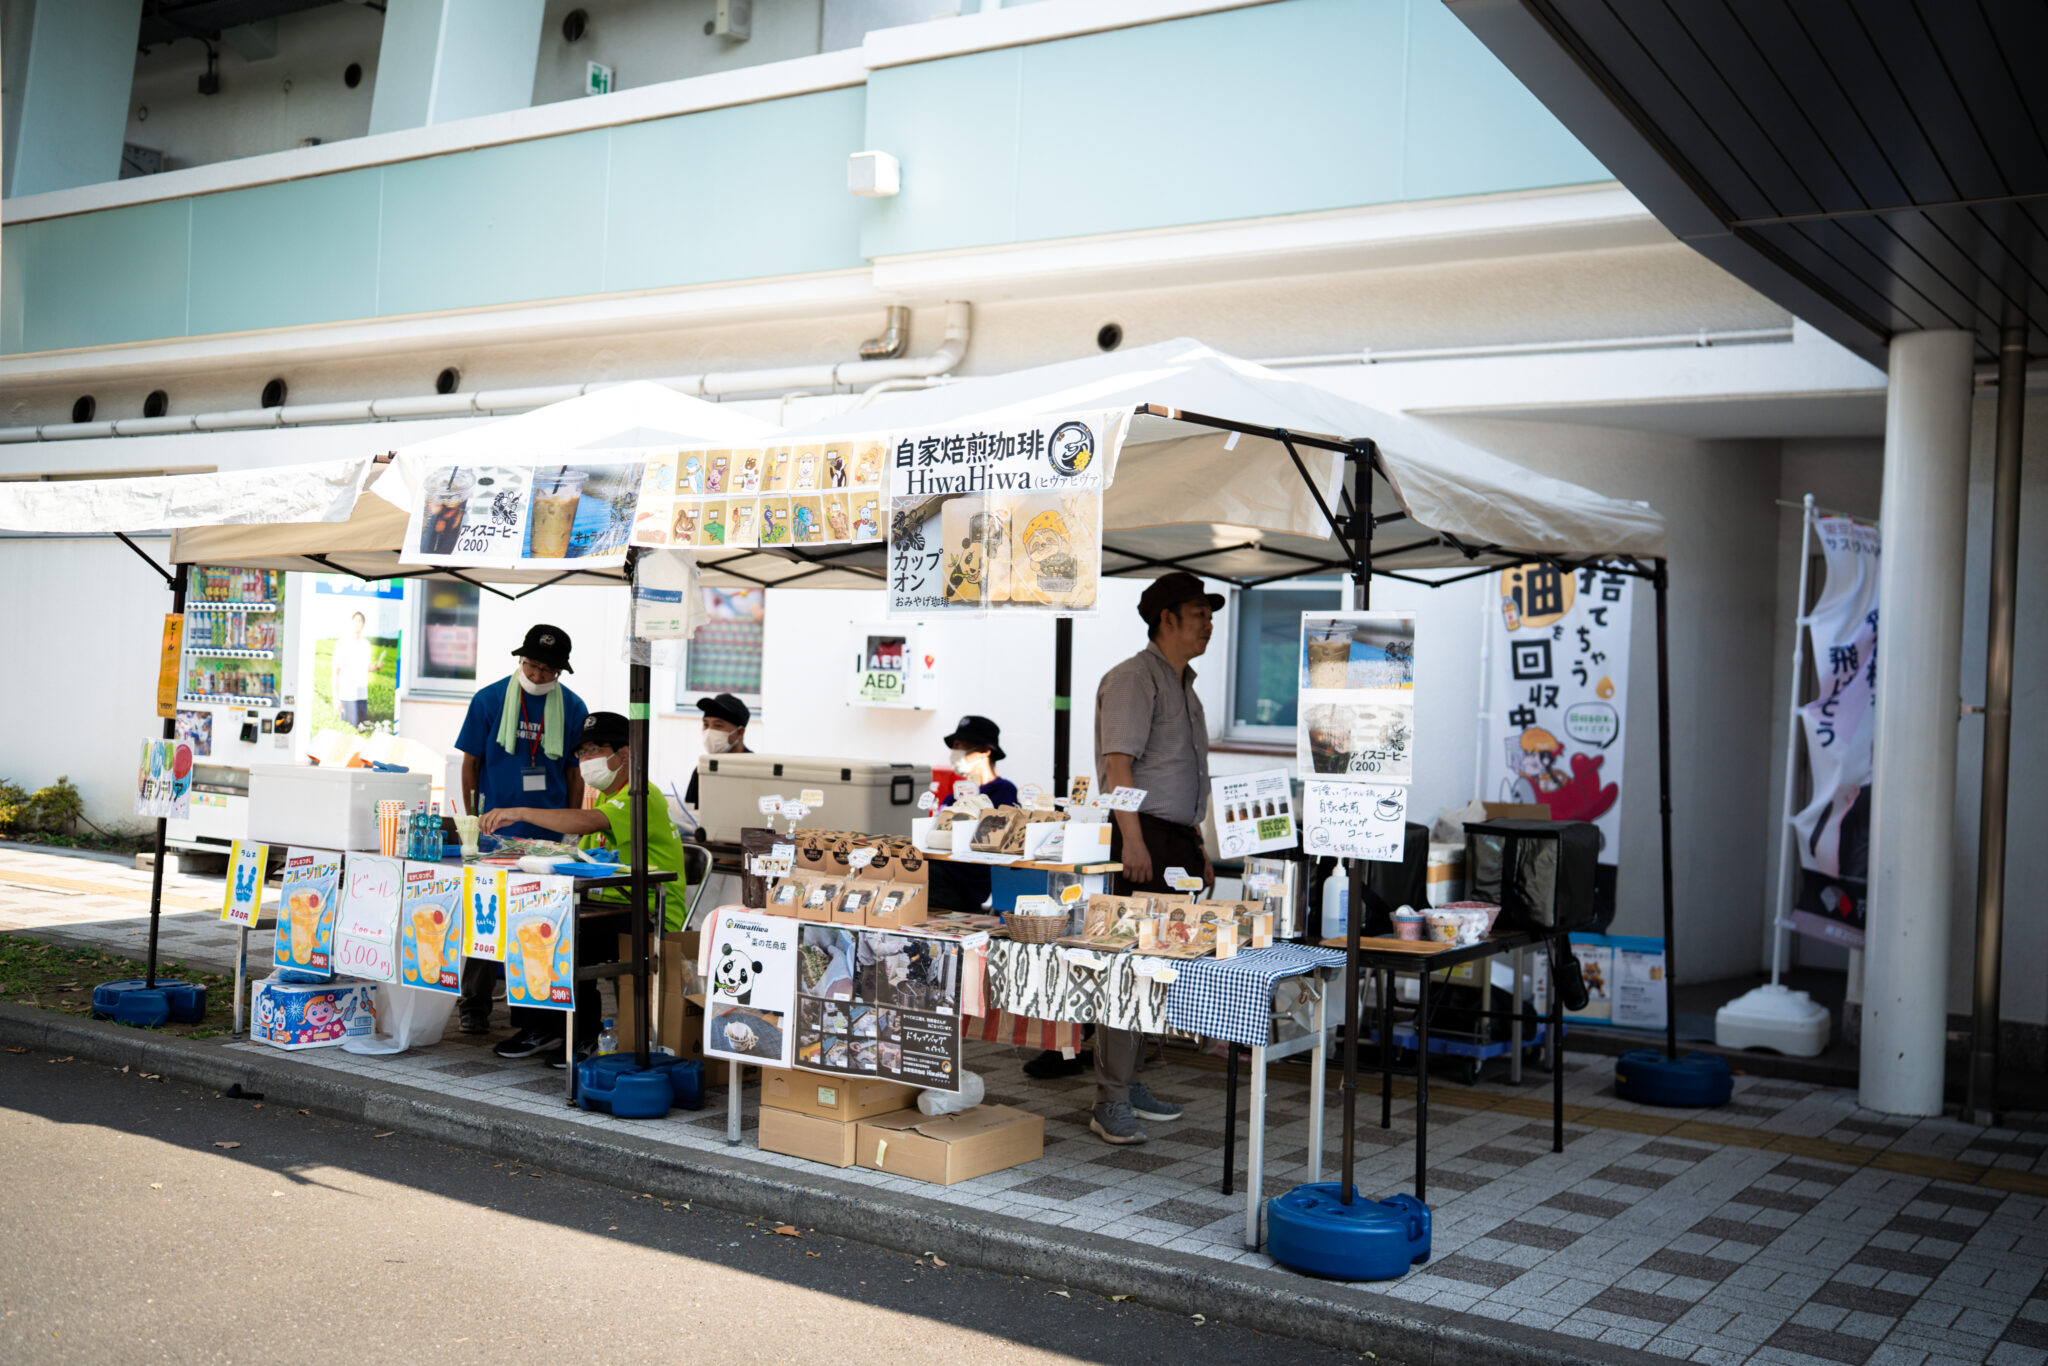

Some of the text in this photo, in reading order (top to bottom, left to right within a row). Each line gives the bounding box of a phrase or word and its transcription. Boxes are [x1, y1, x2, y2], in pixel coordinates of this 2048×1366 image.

[896, 428, 1045, 468] 自家焙煎珈琲
[906, 463, 1032, 495] HiwaHiwa
[460, 524, 519, 539] アイスコーヒー
[457, 538, 489, 552] (200)
[894, 548, 944, 572] カップ
[893, 573, 926, 592] オン
[895, 596, 950, 608] おみやげ珈琲
[1572, 560, 1626, 687] 捨てちゃう
[1509, 561, 1564, 729] 油を回収中
[865, 673, 897, 689] AED
[1350, 761, 1381, 772] (200)
[240, 849, 256, 859] ラムネ
[287, 863, 338, 883] フルーツポンチ
[475, 876, 494, 885] ラムネ
[351, 872, 397, 899] ビール
[406, 877, 461, 899] フルーツポンチ
[510, 886, 571, 913] フルーツポンチ
[230, 909, 248, 921] 200円
[734, 923, 769, 933] HiwaHiwa
[340, 939, 391, 976] 500円
[474, 942, 495, 954] 200円
